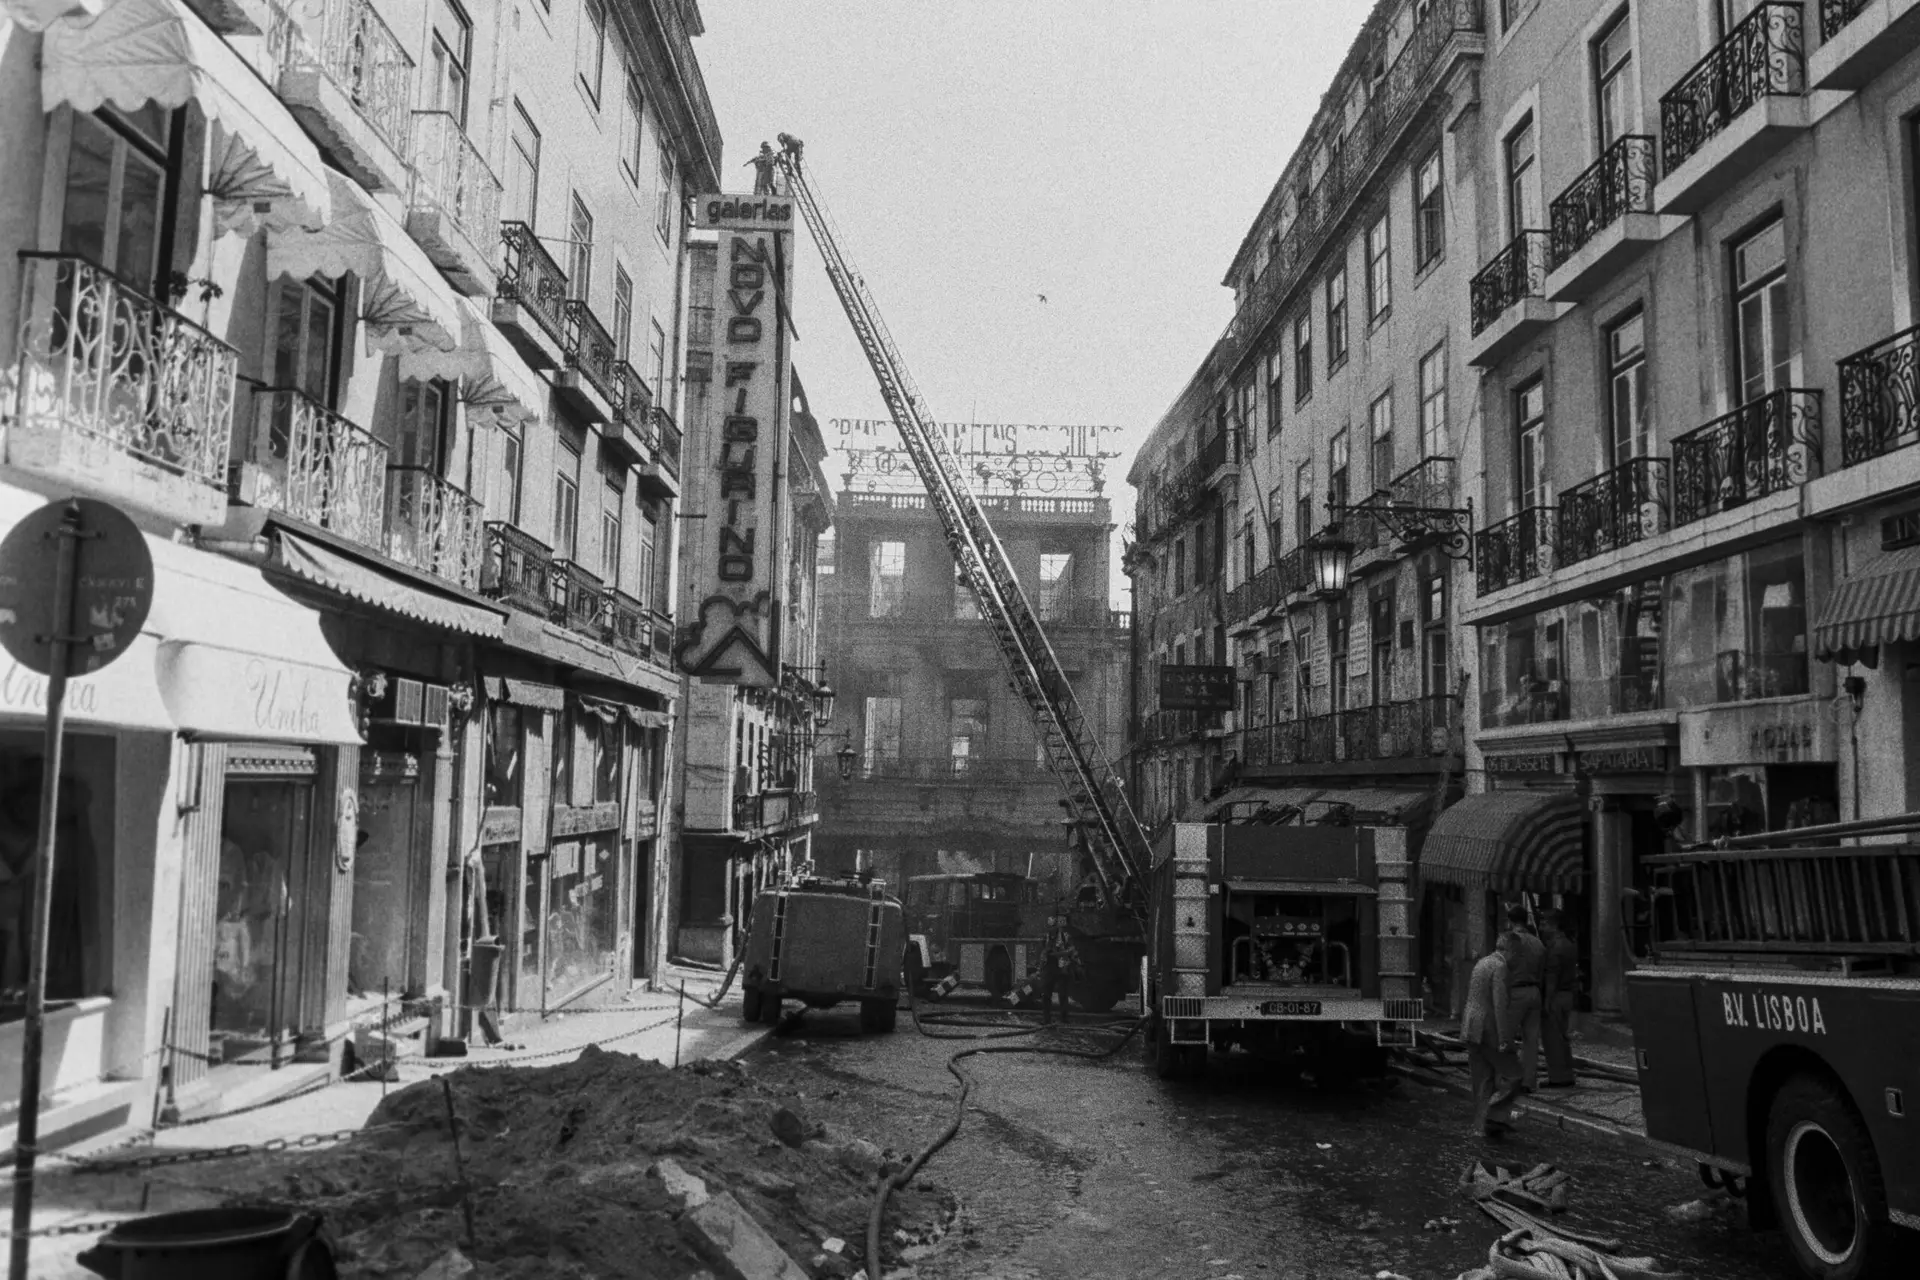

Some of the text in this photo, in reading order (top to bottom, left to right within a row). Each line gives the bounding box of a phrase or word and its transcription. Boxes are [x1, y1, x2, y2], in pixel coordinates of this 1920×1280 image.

[706, 198, 791, 223] galerias
[1721, 991, 1827, 1036] B.V. LISBOA
